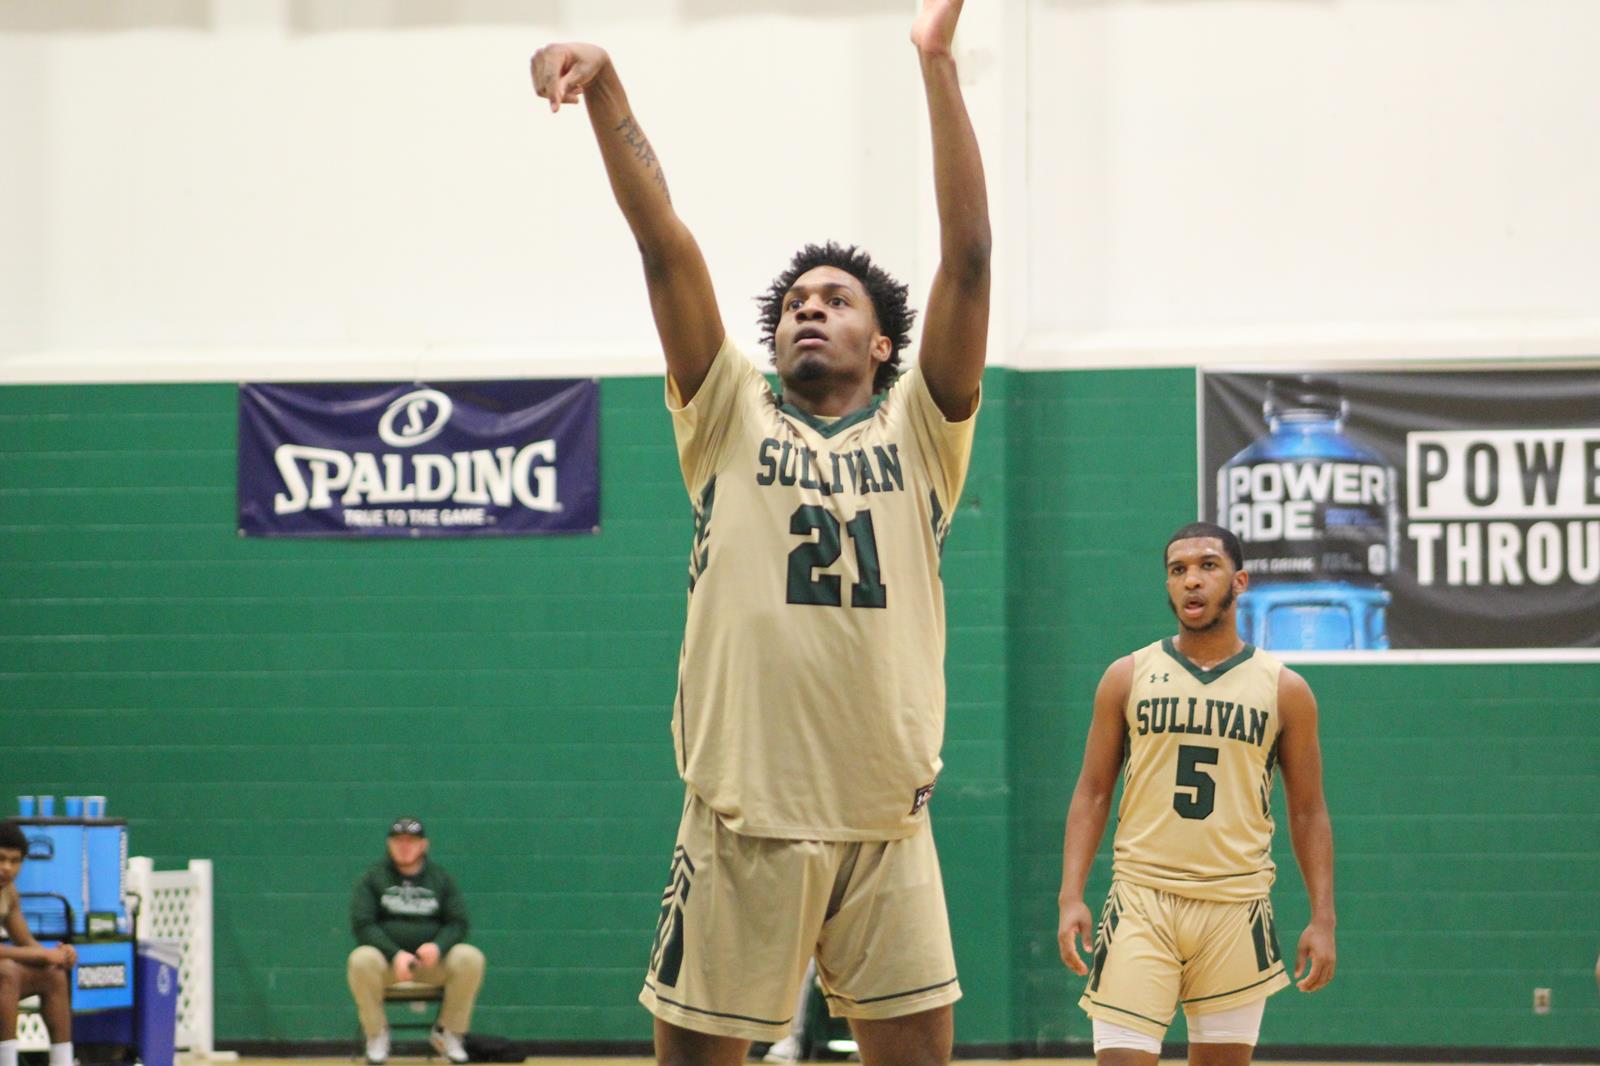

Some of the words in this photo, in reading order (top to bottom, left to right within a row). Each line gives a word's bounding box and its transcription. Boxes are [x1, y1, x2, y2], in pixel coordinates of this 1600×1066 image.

[402, 400, 427, 436] S
[274, 439, 563, 514] SPALDING
[1229, 463, 1386, 505] POWER
[1418, 441, 1600, 508] POWE
[343, 508, 384, 526] TRUE
[386, 509, 407, 526] TO
[408, 509, 438, 526] THE
[439, 508, 486, 526] GAME
[1229, 500, 1315, 542] ADE
[786, 504, 887, 609] 21
[1407, 520, 1600, 586] THROU
[1136, 697, 1269, 747] SULLIVAN
[1173, 744, 1219, 821] 5
